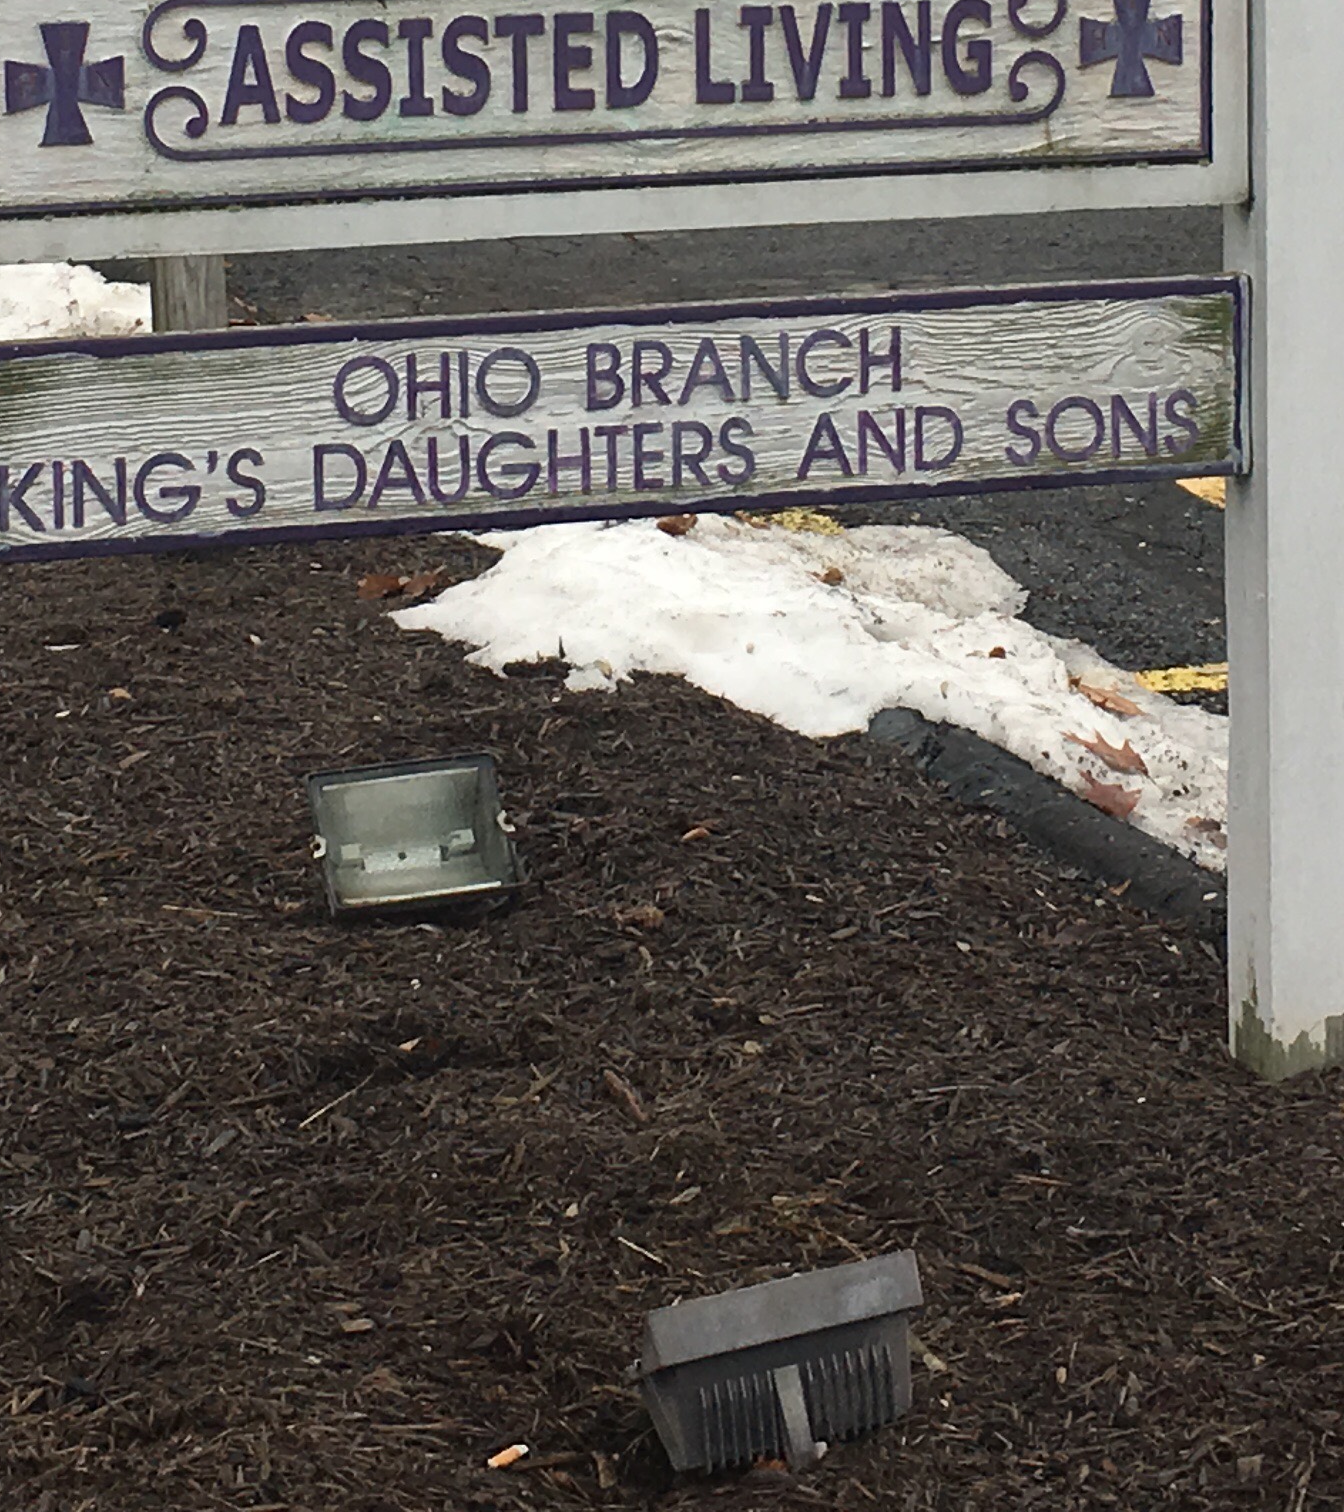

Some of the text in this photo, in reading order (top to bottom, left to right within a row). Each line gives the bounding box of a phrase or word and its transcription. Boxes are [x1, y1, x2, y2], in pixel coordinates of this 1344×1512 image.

[218, 9, 658, 125] ASSISTED
[333, 325, 902, 427] OHIO BRANCH
[312, 416, 756, 512] DAUGHTERS
[796, 405, 964, 480] AND
[1004, 388, 1199, 466] SONS
